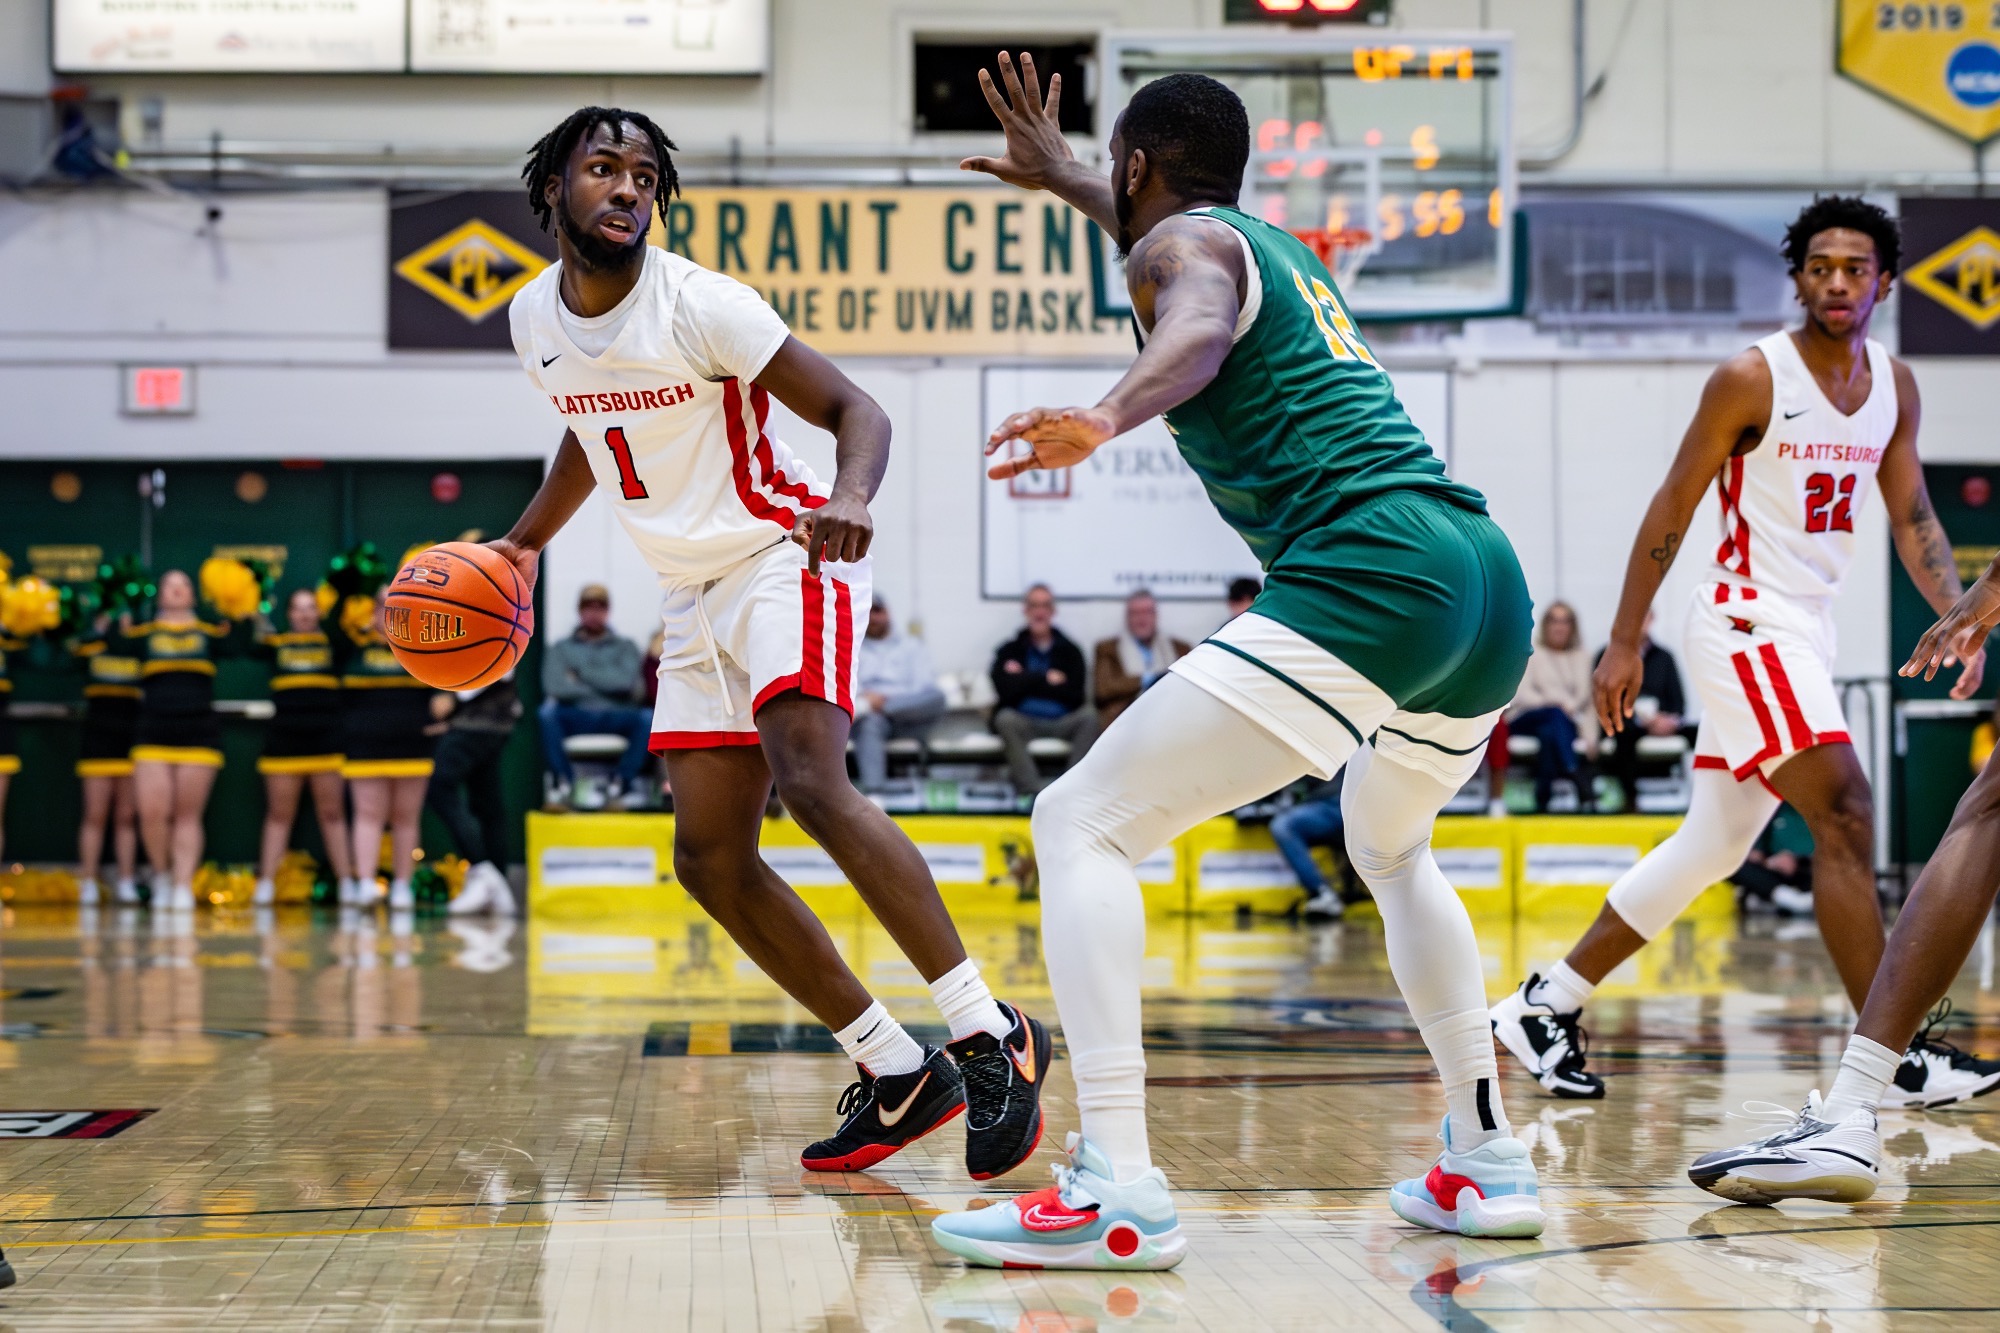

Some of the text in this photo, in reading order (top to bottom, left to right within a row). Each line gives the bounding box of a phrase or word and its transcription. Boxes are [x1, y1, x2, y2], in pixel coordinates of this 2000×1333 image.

[1878, 4, 1963, 30] 2019
[757, 287, 821, 331] ME
[837, 288, 879, 332] OF
[895, 289, 973, 332] UVM
[1291, 266, 1387, 372] 12
[549, 383, 695, 415] LATTSBURGH
[604, 426, 650, 501] 1
[1778, 442, 1881, 463] PLATTSBURG
[1804, 472, 1857, 534] 22
[420, 609, 467, 644] THE
